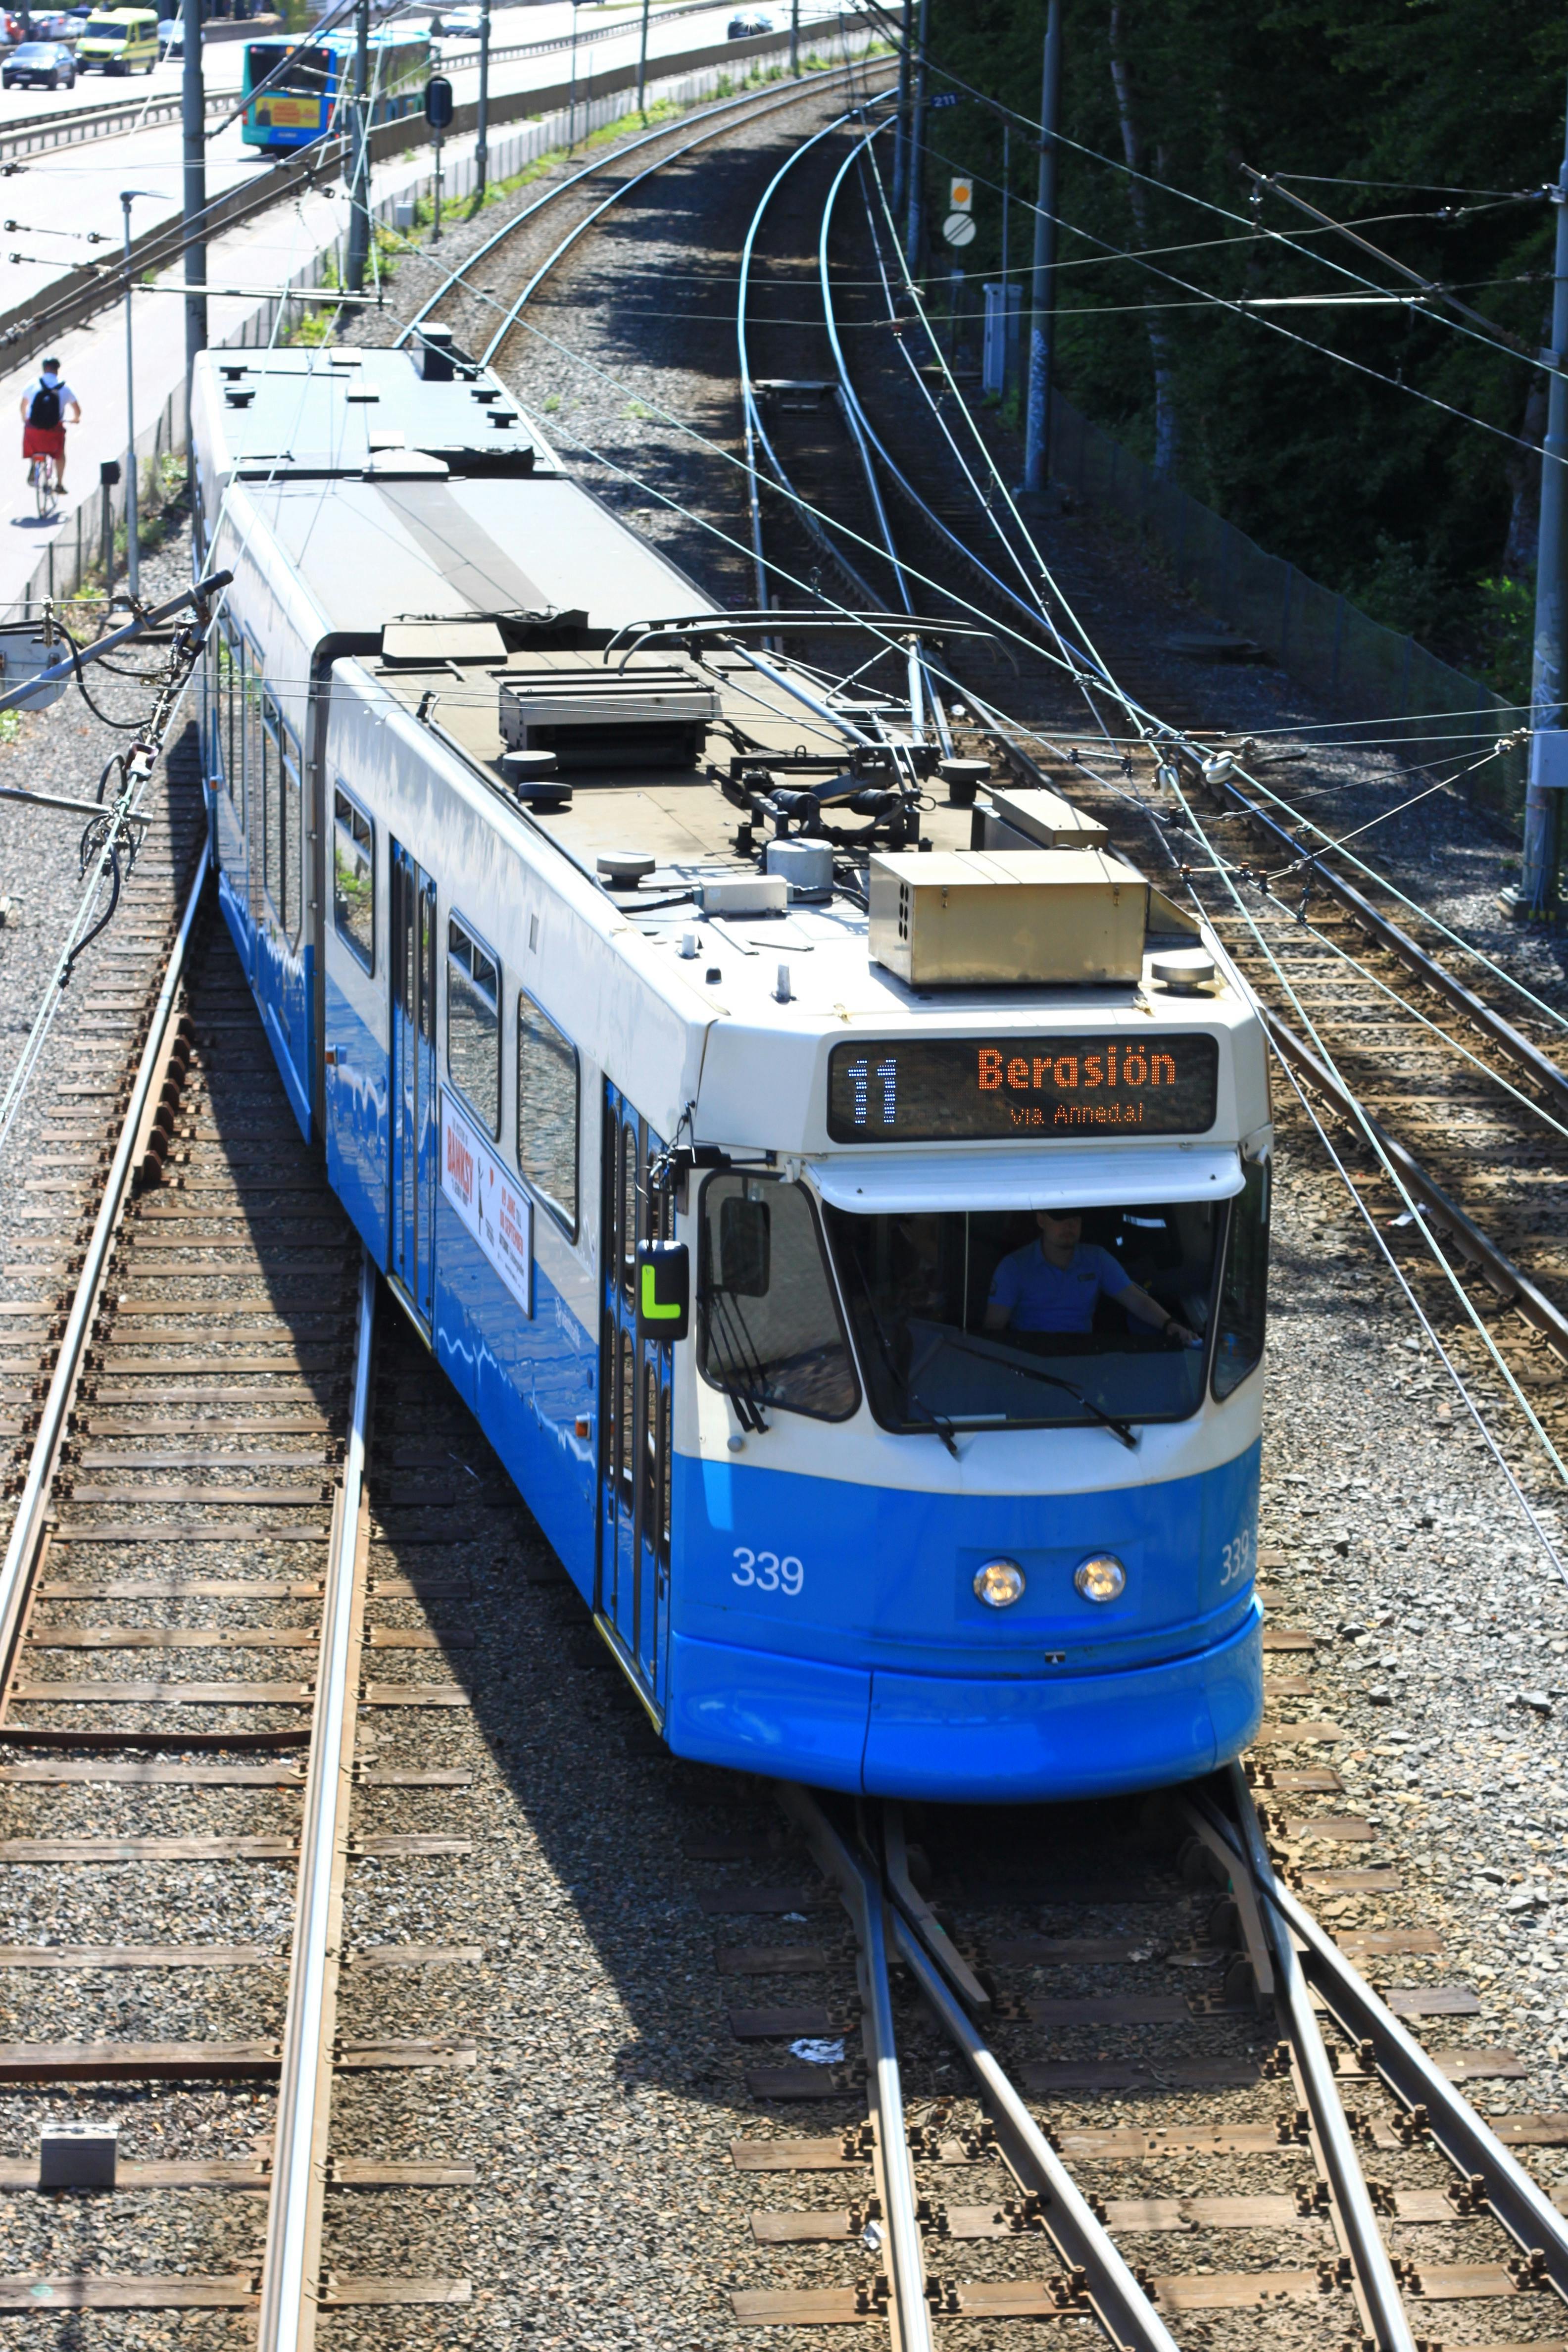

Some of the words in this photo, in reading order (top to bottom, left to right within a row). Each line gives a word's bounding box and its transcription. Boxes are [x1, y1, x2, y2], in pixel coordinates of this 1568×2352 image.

[933, 95, 956, 107] 211
[848, 1059, 896, 1124] 11
[1010, 1108, 1045, 1125] via
[1054, 1101, 1144, 1125] Annedal
[447, 1125, 473, 1204] BANKSY
[641, 1264, 681, 1319] L
[731, 1546, 804, 1596] 339
[1220, 1529, 1249, 1586] 339
